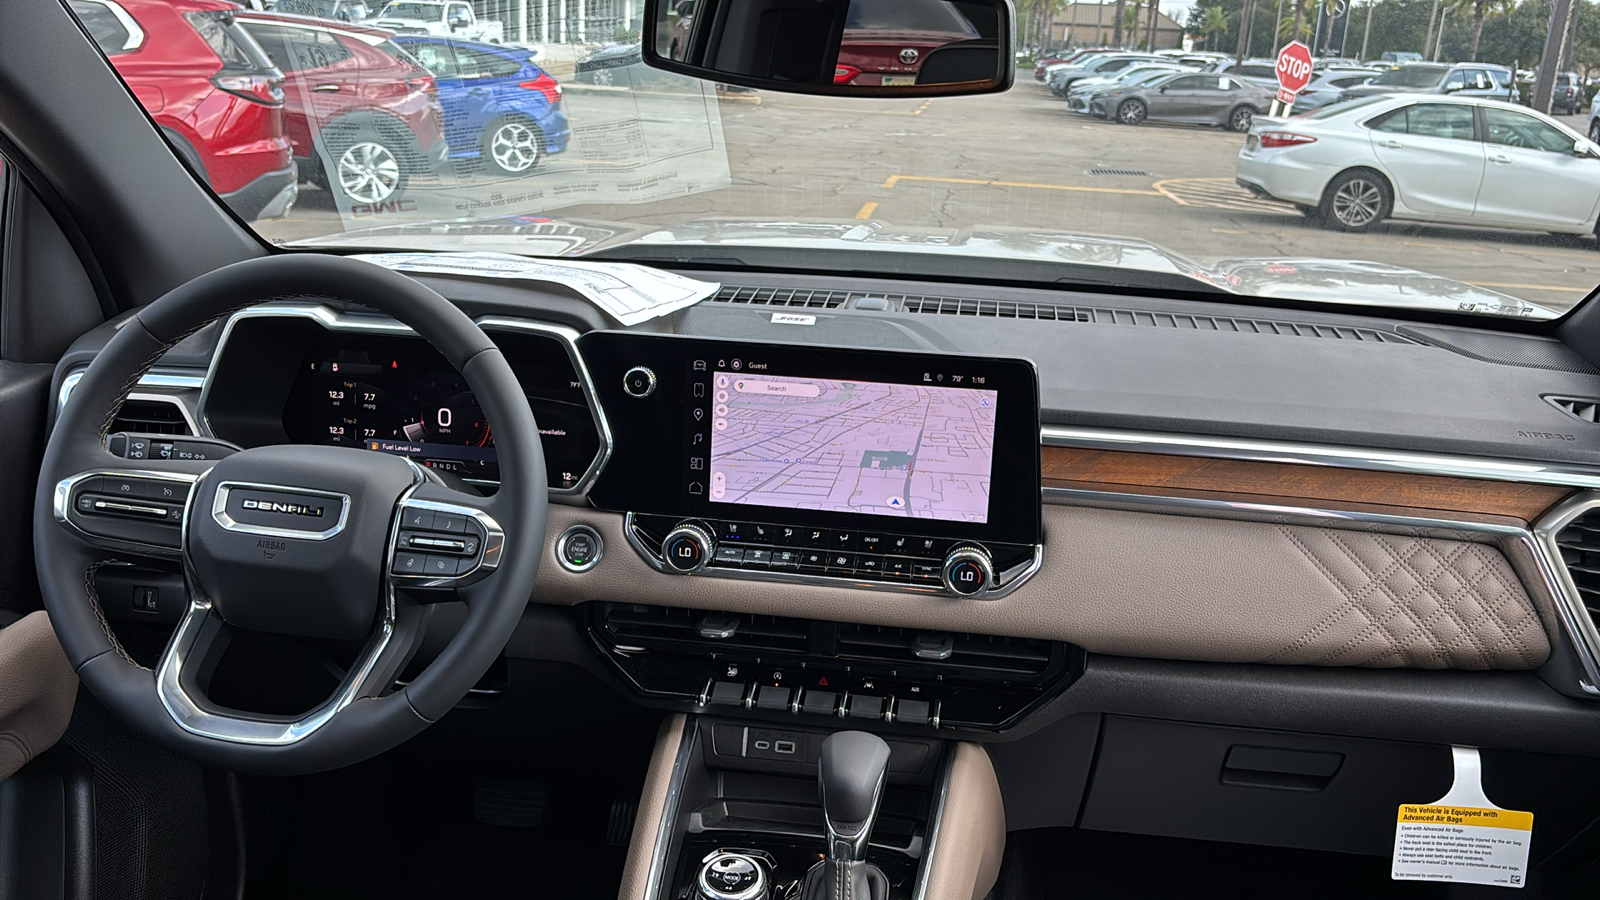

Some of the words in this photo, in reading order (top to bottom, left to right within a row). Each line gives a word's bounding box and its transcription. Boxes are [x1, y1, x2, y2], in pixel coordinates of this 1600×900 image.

[1279, 54, 1310, 80] STOP
[748, 362, 768, 370] Guest
[328, 391, 344, 399] 12.3
[363, 393, 376, 401] 7.7
[437, 408, 452, 427] 0
[329, 426, 344, 434] 12.3
[1516, 431, 1576, 442] AIRBAG
[562, 472, 571, 480] 12
[242, 499, 325, 517] DENALI
[256, 540, 286, 551] AIRBAG
[1451, 809, 1482, 817] Equipped
